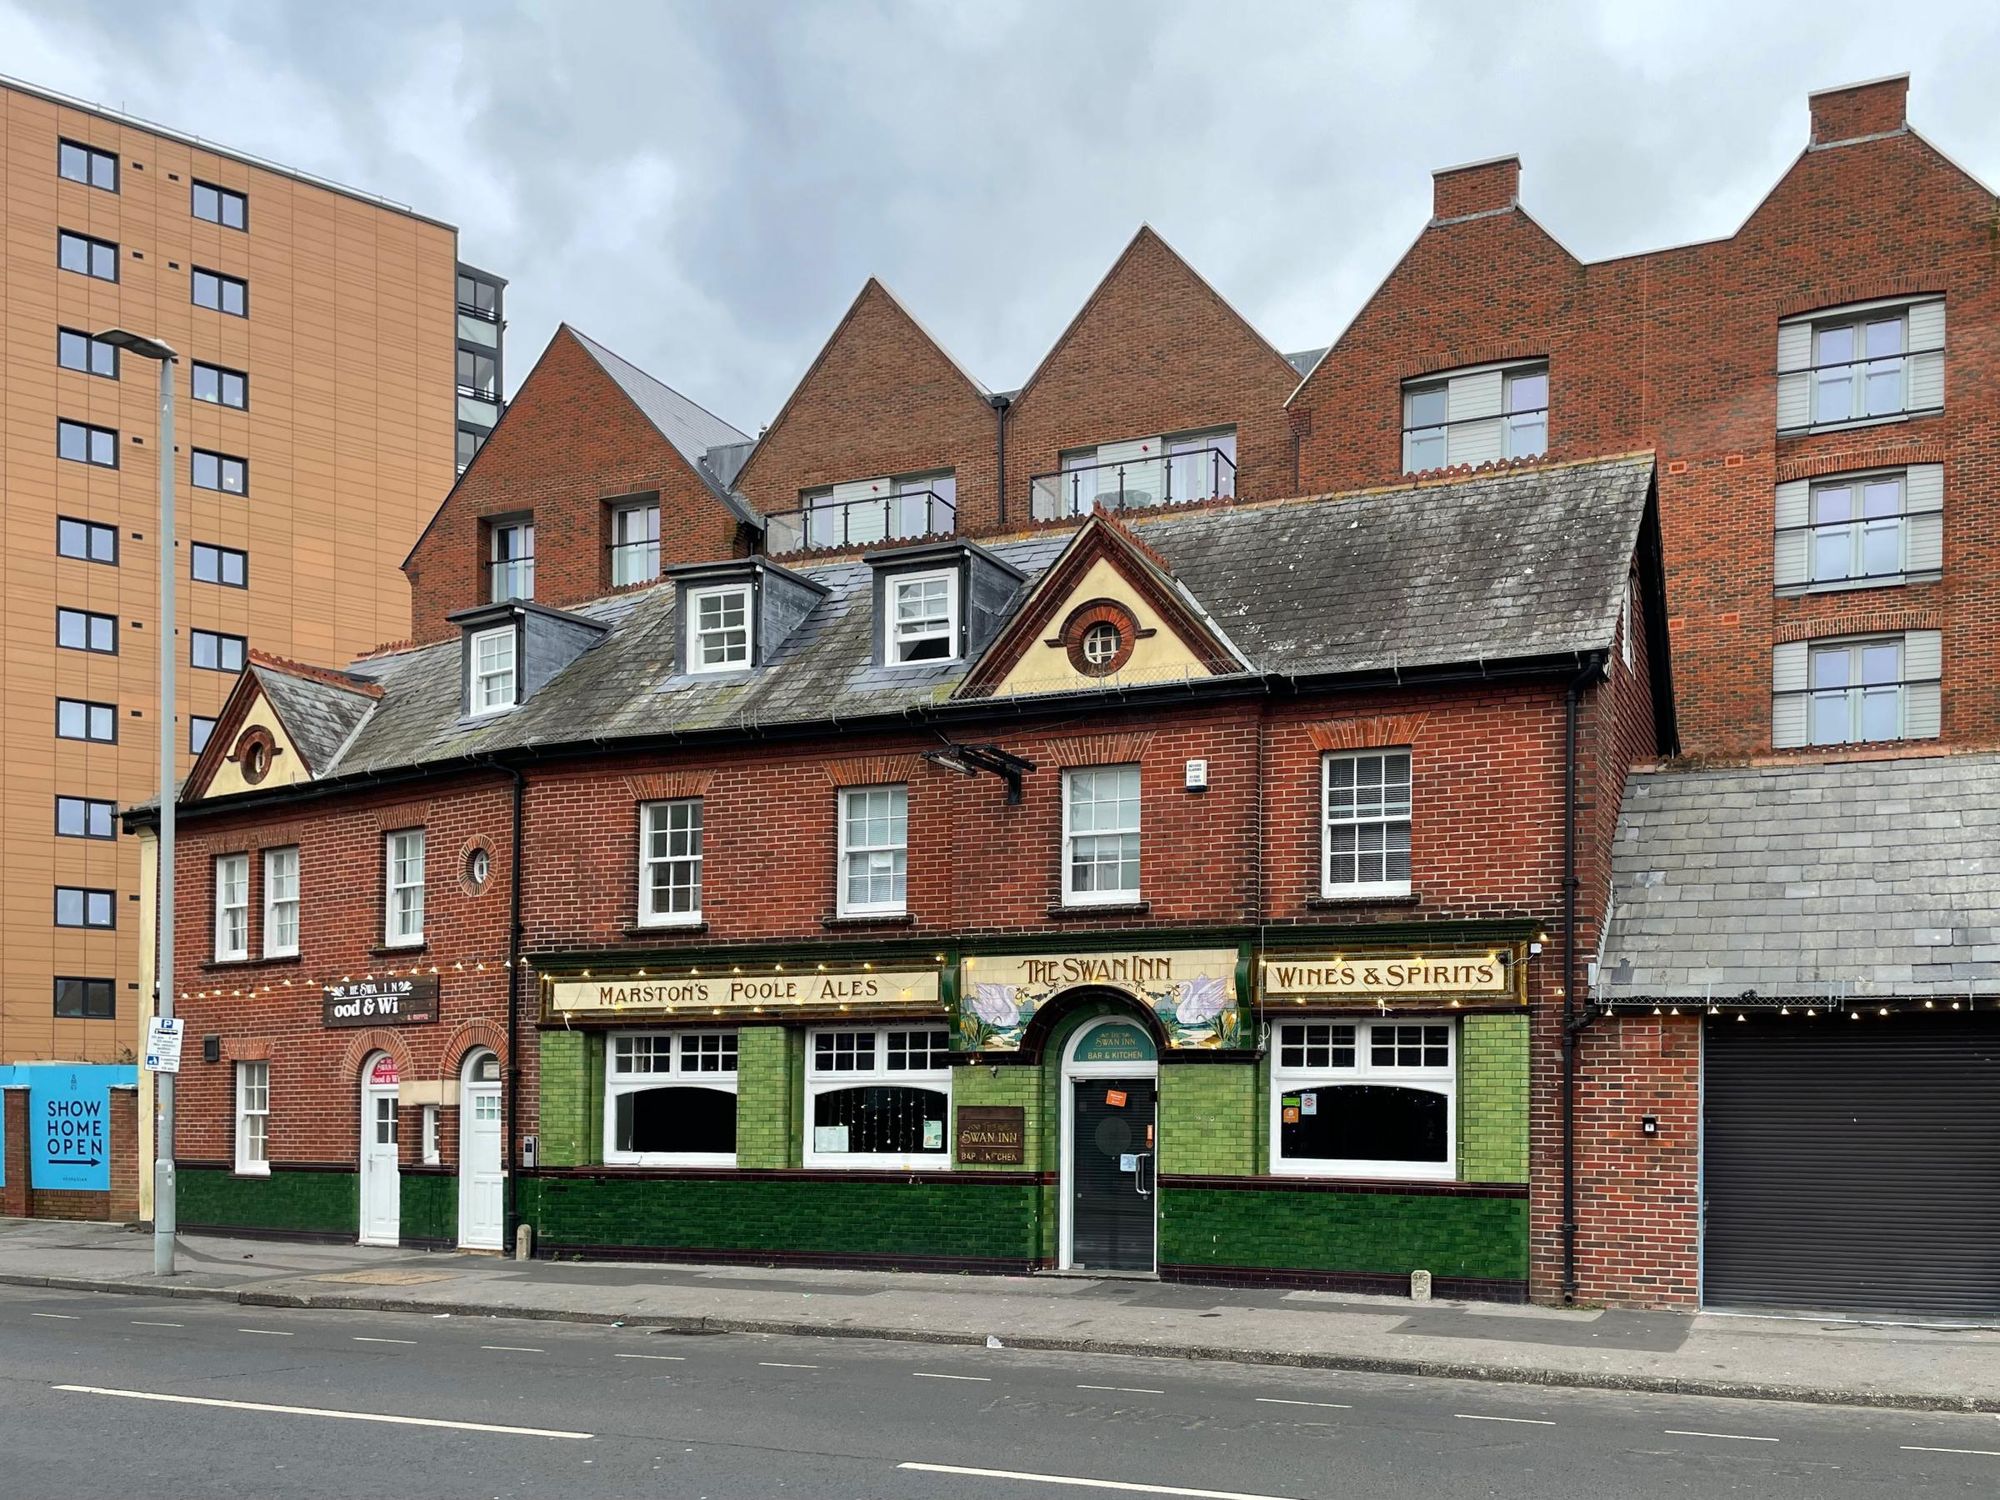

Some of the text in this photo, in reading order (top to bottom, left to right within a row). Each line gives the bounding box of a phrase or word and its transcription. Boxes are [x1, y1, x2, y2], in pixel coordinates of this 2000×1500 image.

[1017, 955, 1172, 986] THE SWAN INN
[1276, 964, 1494, 988] WINES & SPIRITS
[599, 980, 878, 1005] MARSTON'S POOLE ALES
[334, 999, 361, 1018] ood
[363, 998, 376, 1016] &
[1095, 1036, 1136, 1048] SWAN INN
[1087, 1050, 1143, 1060] BAR & KITCHEN
[47, 1100, 101, 1117] SHOW
[47, 1120, 102, 1137] HOME
[960, 1130, 1017, 1144] SWAN INN
[47, 1138, 102, 1155] OPEN
